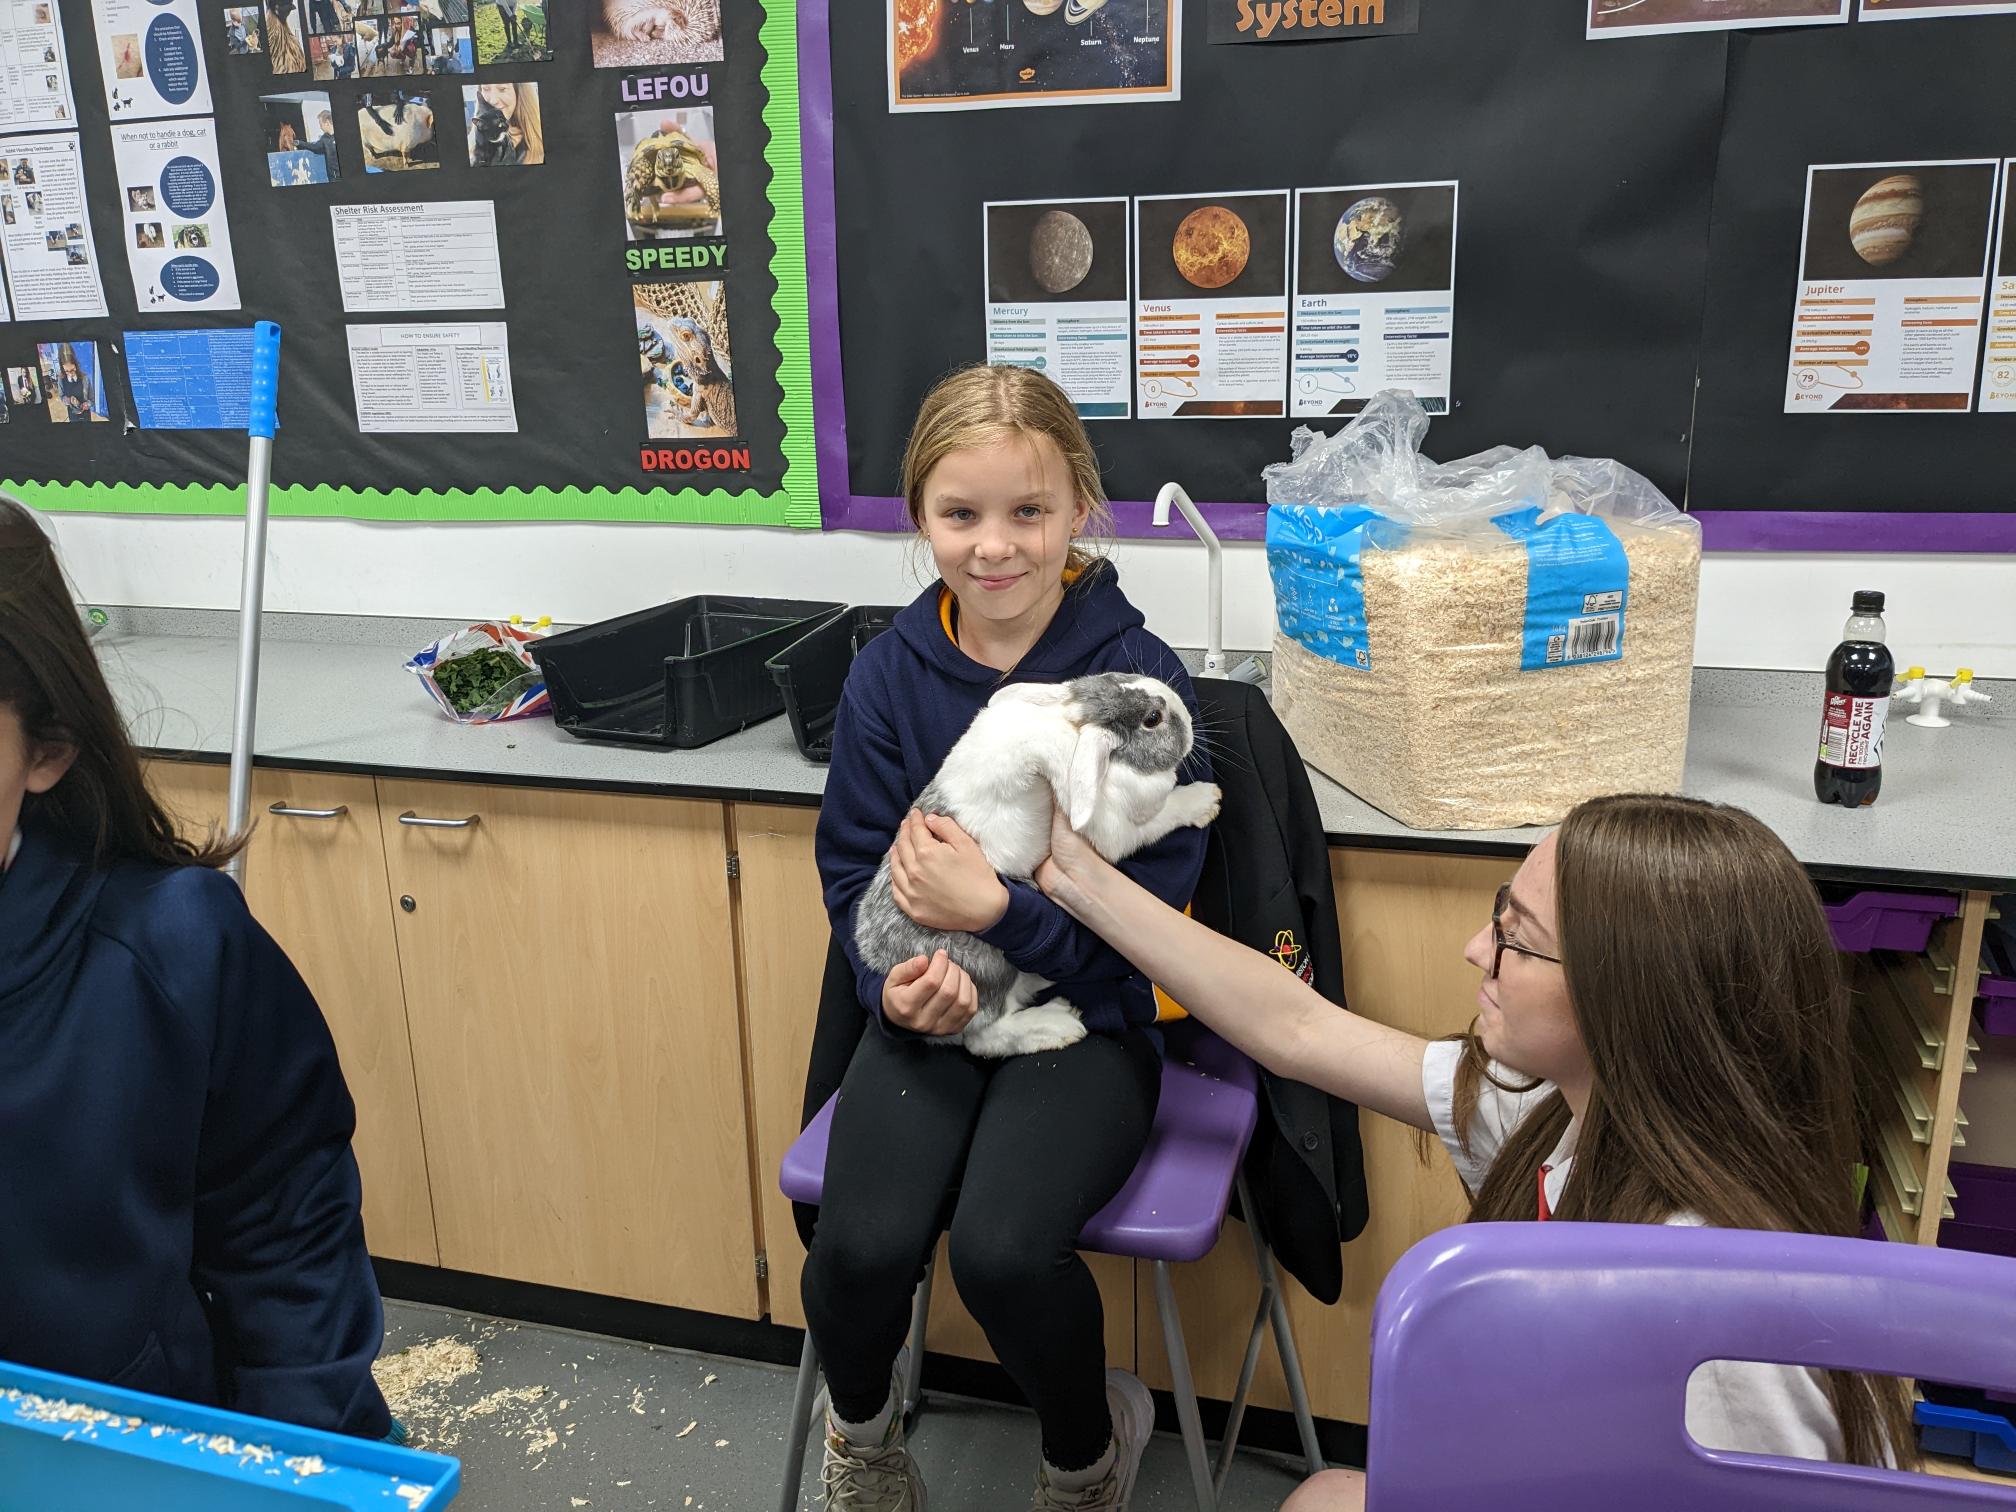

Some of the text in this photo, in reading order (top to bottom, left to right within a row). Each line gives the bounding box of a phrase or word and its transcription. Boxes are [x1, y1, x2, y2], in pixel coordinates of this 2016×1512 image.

[1235, 0, 1385, 38] System
[1133, 36, 1160, 44] Neptune
[621, 74, 709, 102] LEFOU
[335, 204, 424, 216] Shelter Risk Assessment
[626, 244, 727, 271] SPEEDY
[1805, 285, 1845, 296] Jupiter
[1144, 304, 1171, 312] Venus
[1301, 299, 1327, 307] Earth
[993, 307, 1029, 317] Mercury
[1802, 374, 1813, 382] 79
[1997, 371, 2010, 379] 82
[641, 448, 750, 471] DROGON
[1861, 702, 1874, 740] AGAIN
[1848, 701, 1864, 765] RECYCLE ME
